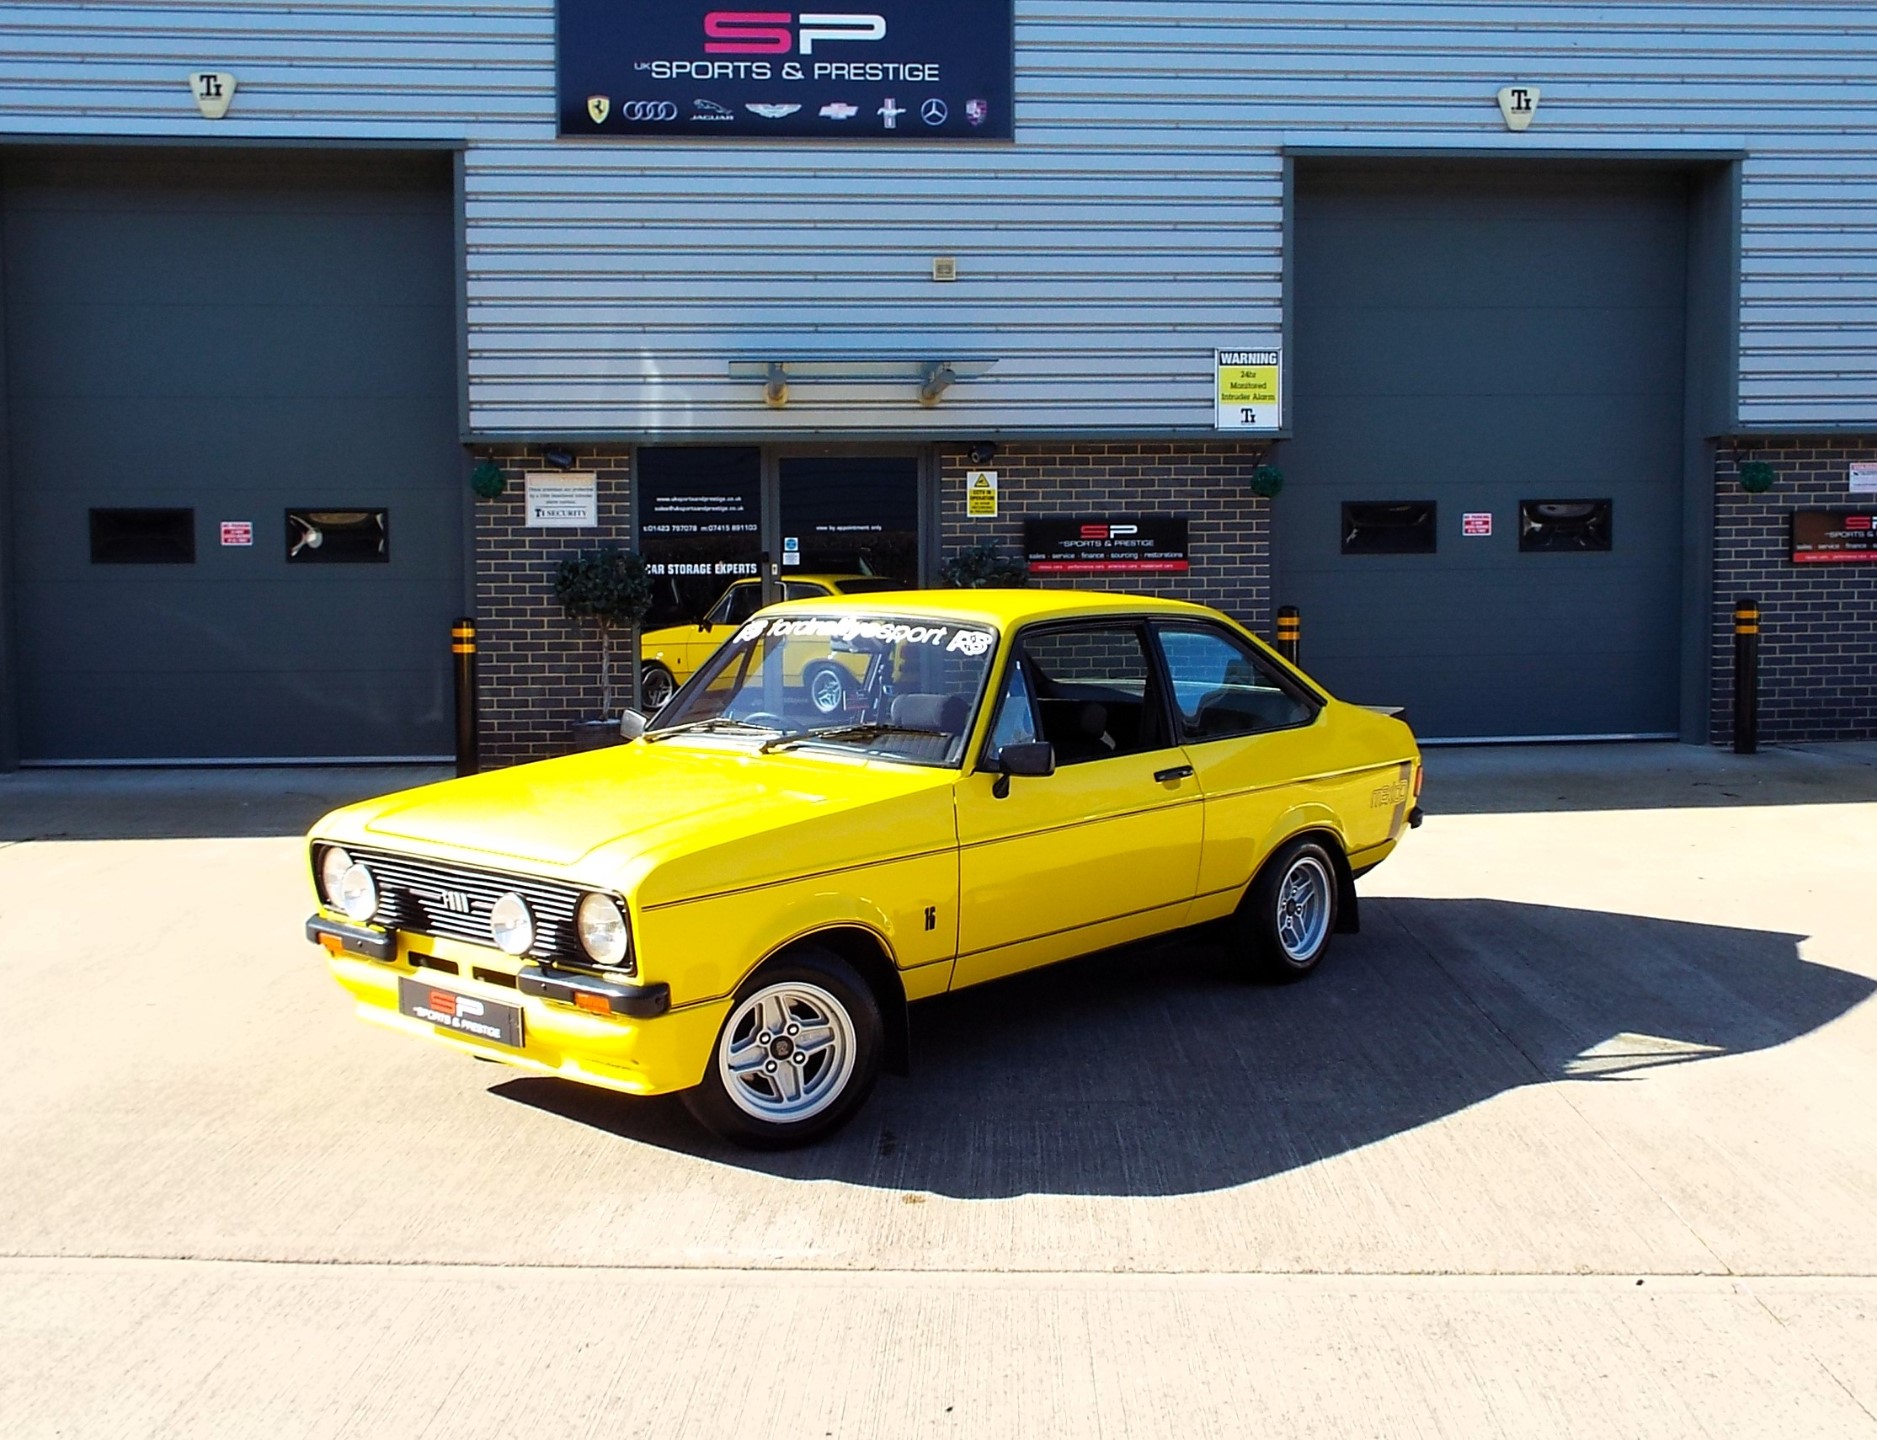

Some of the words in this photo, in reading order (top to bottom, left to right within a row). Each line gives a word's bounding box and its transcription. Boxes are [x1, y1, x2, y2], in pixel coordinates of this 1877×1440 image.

[703, 12, 887, 55] SP
[781, 62, 805, 81] &
[813, 62, 940, 82] PRESTIGE
[1220, 352, 1277, 365] WARNING
[1846, 517, 1877, 529] S
[1080, 525, 1138, 539] SP
[1111, 552, 1138, 560] sourcing
[667, 563, 712, 575] STORAGE
[715, 563, 757, 574] EXPERTS
[946, 630, 993, 656] RS
[429, 990, 485, 1017] SP
[452, 1016, 461, 1028] &
